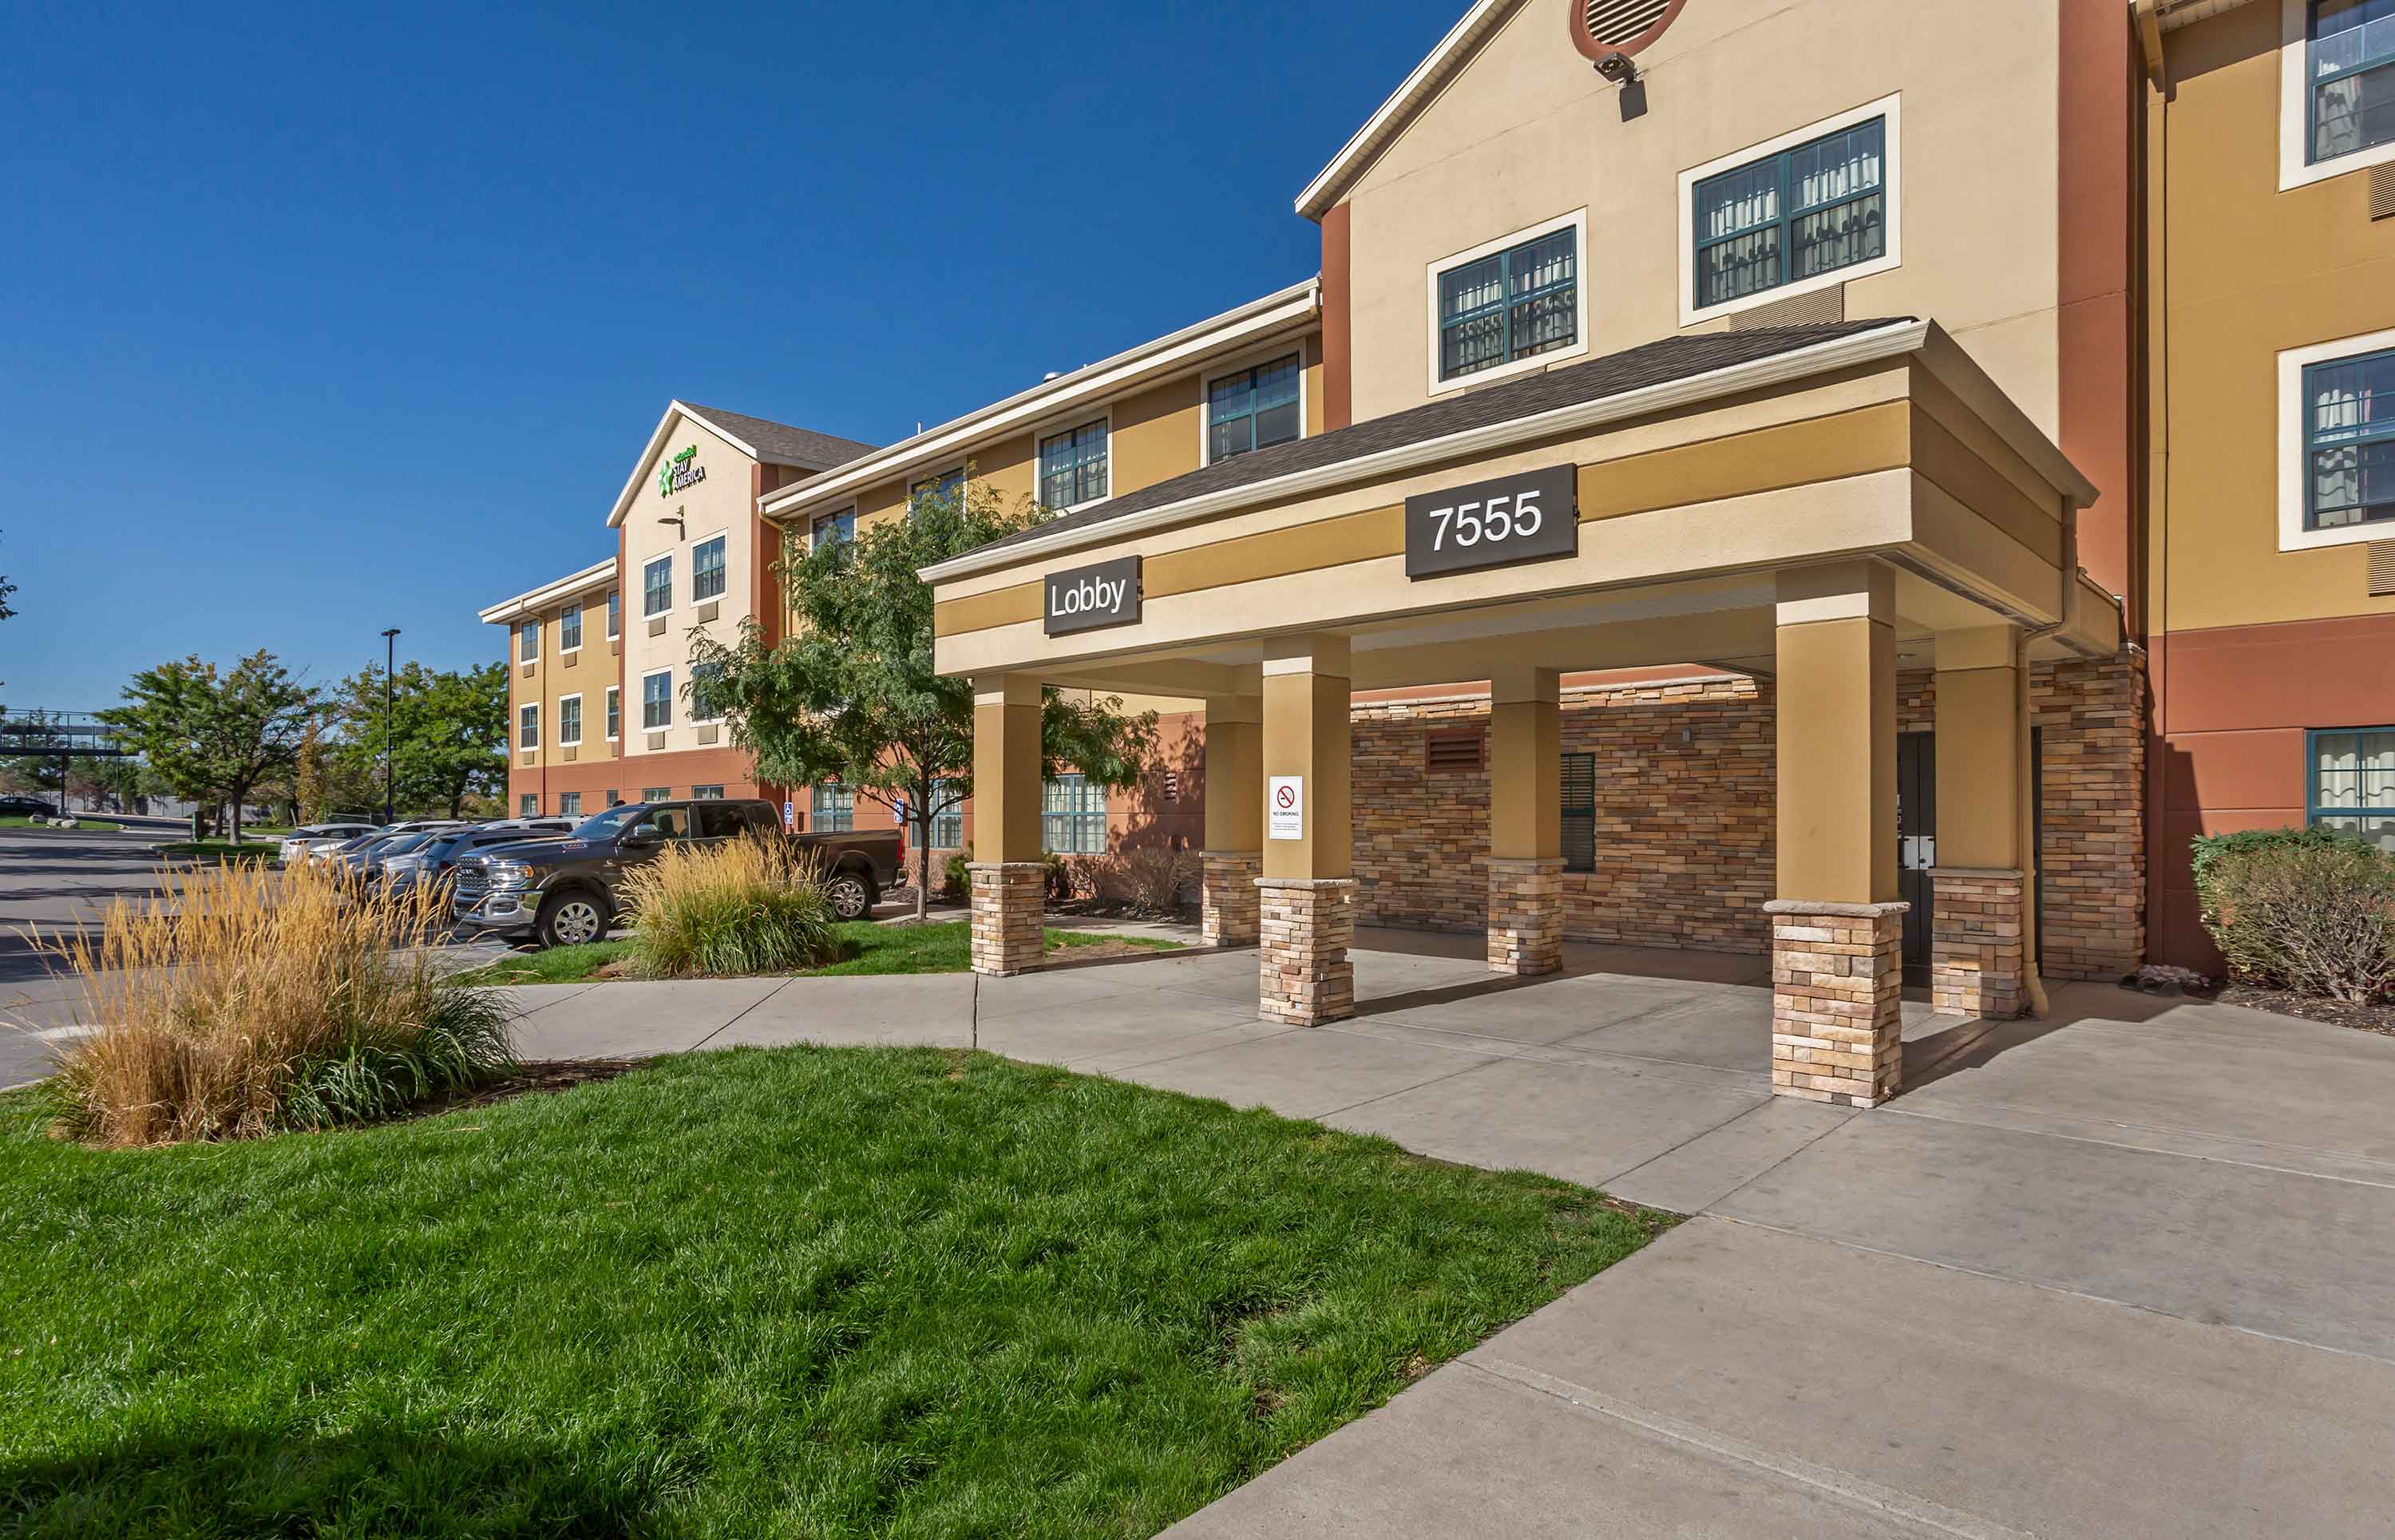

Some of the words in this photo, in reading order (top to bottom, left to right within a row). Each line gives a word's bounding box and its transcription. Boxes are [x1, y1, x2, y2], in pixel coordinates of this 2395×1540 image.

[673, 459, 690, 477] STAY
[674, 466, 705, 490] AMERICA
[1429, 489, 1542, 552] 7555
[1051, 576, 1126, 616] Lobby
